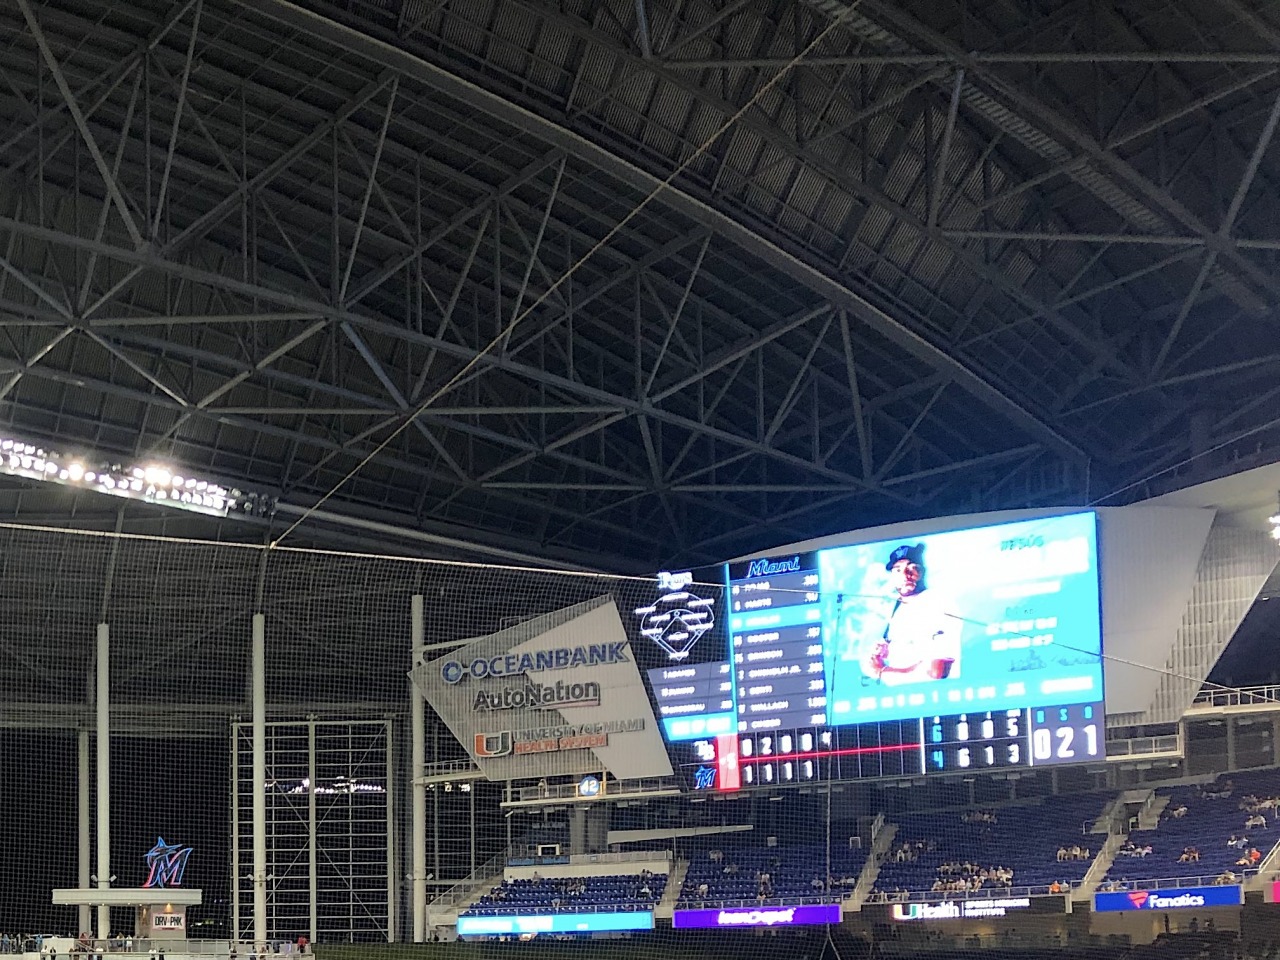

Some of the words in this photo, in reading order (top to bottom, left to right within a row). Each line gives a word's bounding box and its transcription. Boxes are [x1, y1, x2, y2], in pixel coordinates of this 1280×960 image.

[746, 556, 800, 577] Miami
[473, 681, 599, 711] AutoNation
[513, 723, 583, 741] UNIVERSITY
[584, 721, 601, 736] OF
[606, 718, 645, 733] MIAMI
[762, 737, 772, 755] 2
[932, 724, 942, 742] 6
[1007, 718, 1018, 737] 5
[514, 738, 557, 754] HEALTH
[560, 734, 608, 750] SYSTEM
[1033, 728, 1051, 760] 0
[1056, 726, 1075, 758] 2
[1083, 724, 1098, 756] 1
[745, 765, 753, 783] 1
[764, 763, 773, 782] 1
[784, 762, 792, 780] 1
[804, 760, 813, 778] 1
[932, 750, 943, 768] 4
[985, 746, 993, 765] 1
[1008, 744, 1019, 764] 3
[581, 780, 598, 793] 42
[1149, 894, 1205, 908] Fanatics
